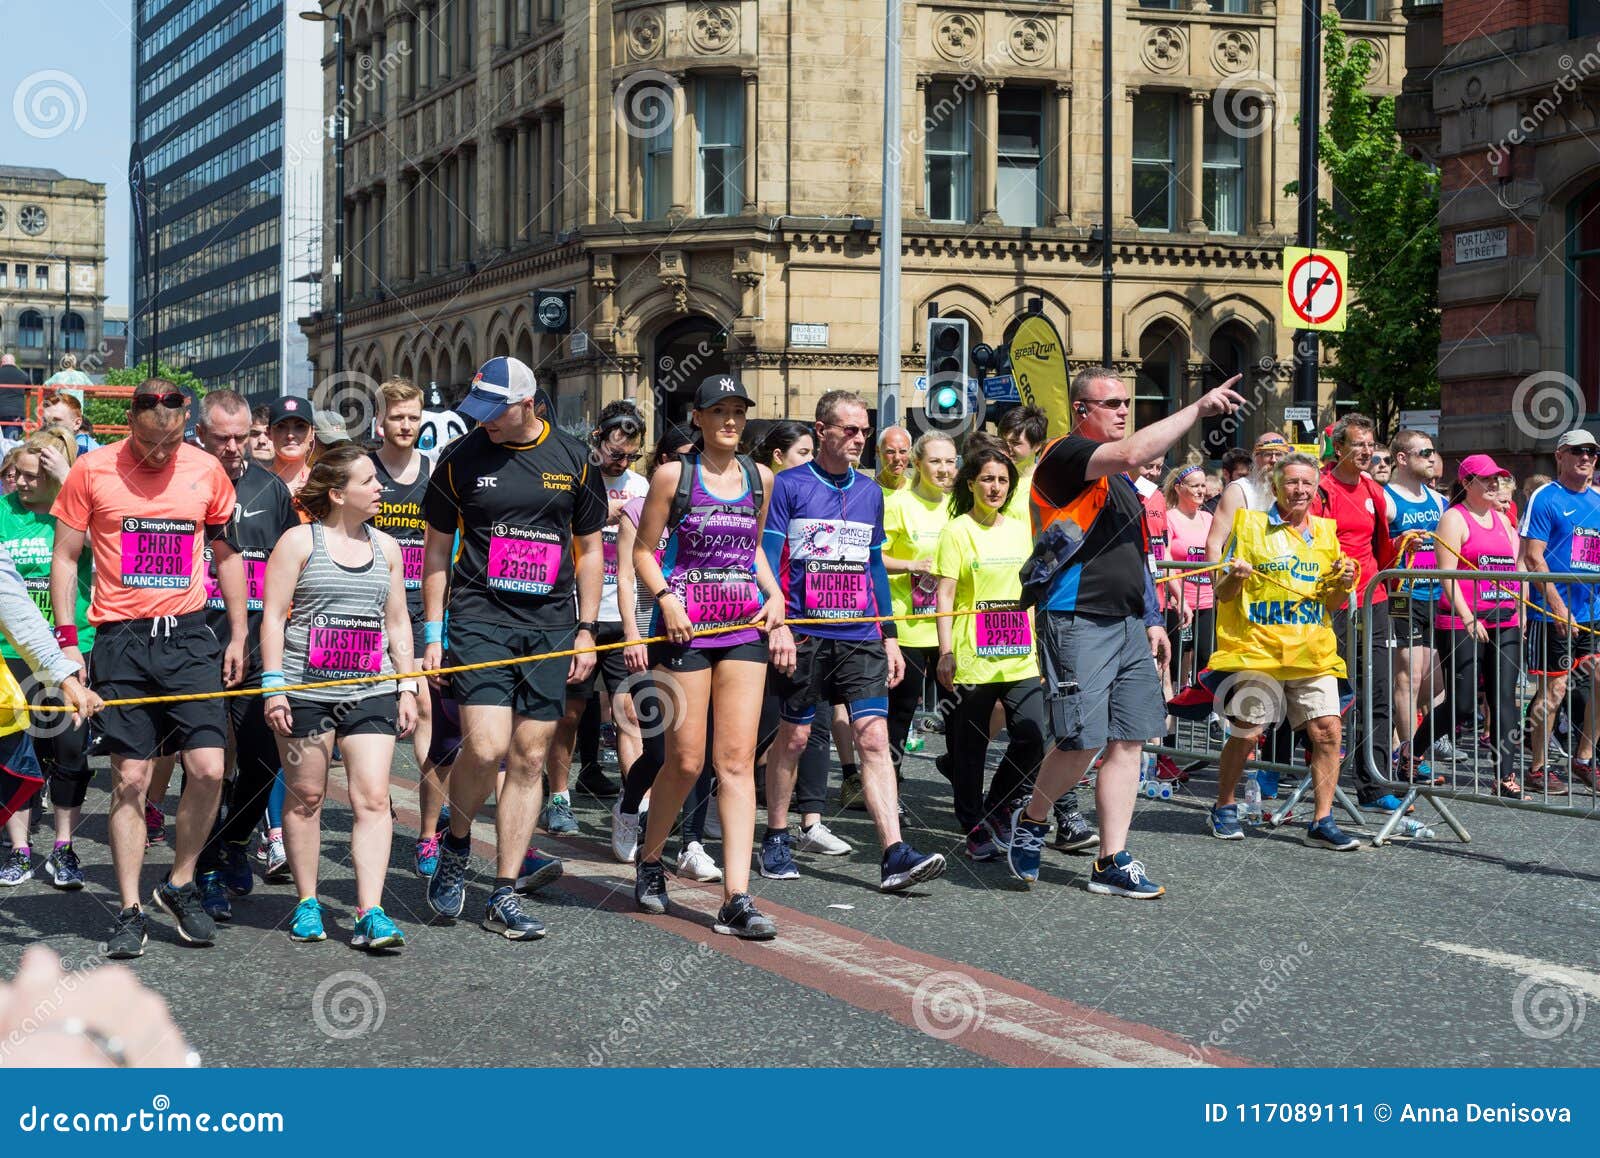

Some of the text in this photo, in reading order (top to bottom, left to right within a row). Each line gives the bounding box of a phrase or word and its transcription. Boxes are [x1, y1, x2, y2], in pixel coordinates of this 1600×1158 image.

[1456, 231, 1505, 247] PORTLAND
[1464, 245, 1496, 259] STREET
[477, 476, 498, 488] STC
[542, 472, 572, 482] Chorlton
[543, 481, 571, 490] Runners
[141, 521, 195, 532] Simplyhealth
[509, 527, 560, 542] Simplyhealth
[21, 537, 47, 547] ARE
[138, 534, 183, 555] CHRIS
[507, 543, 548, 559] ADAM
[134, 554, 184, 575] 22930
[500, 559, 547, 583] 23306
[822, 563, 864, 572] Simplyhealth
[1300, 561, 1319, 572] run
[123, 575, 190, 587] MANCHESTER
[704, 572, 753, 581] Simplyhealth
[811, 574, 863, 592] MICHAEL
[693, 584, 753, 603] GEORGIA
[817, 592, 857, 609] 20165
[807, 609, 864, 618] MANCHESTER
[330, 617, 380, 628] Simplyhealth
[984, 613, 1025, 630] ROBINA
[314, 629, 380, 652] KIRSTINE
[987, 629, 1024, 646] 22527
[978, 645, 1031, 656] MANCHESTER
